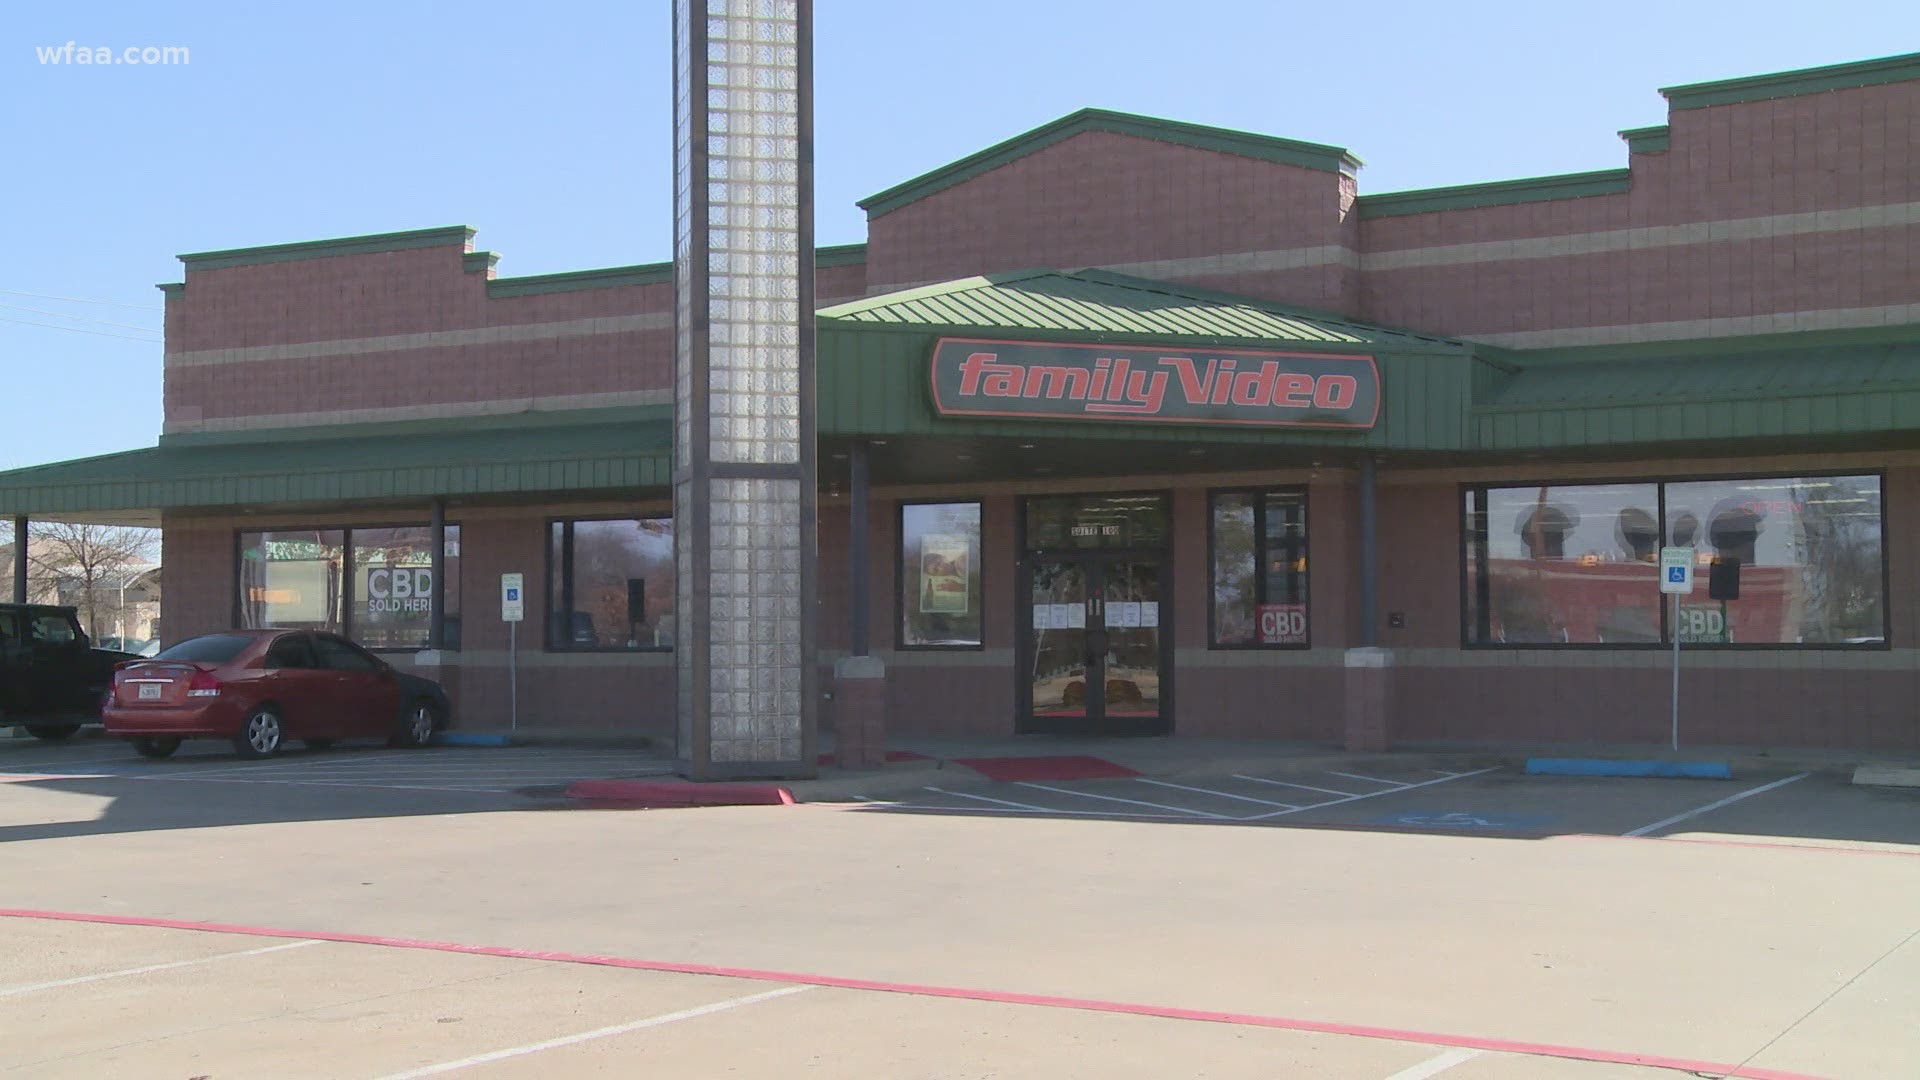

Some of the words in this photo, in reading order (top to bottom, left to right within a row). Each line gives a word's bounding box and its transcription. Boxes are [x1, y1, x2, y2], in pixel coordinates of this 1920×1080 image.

[959, 352, 1168, 414] family
[1159, 357, 1357, 410] Video
[1741, 500, 1802, 515] OPEN
[369, 569, 432, 598] CBD
[369, 599, 400, 611] SOLD
[1261, 612, 1306, 636] CBD
